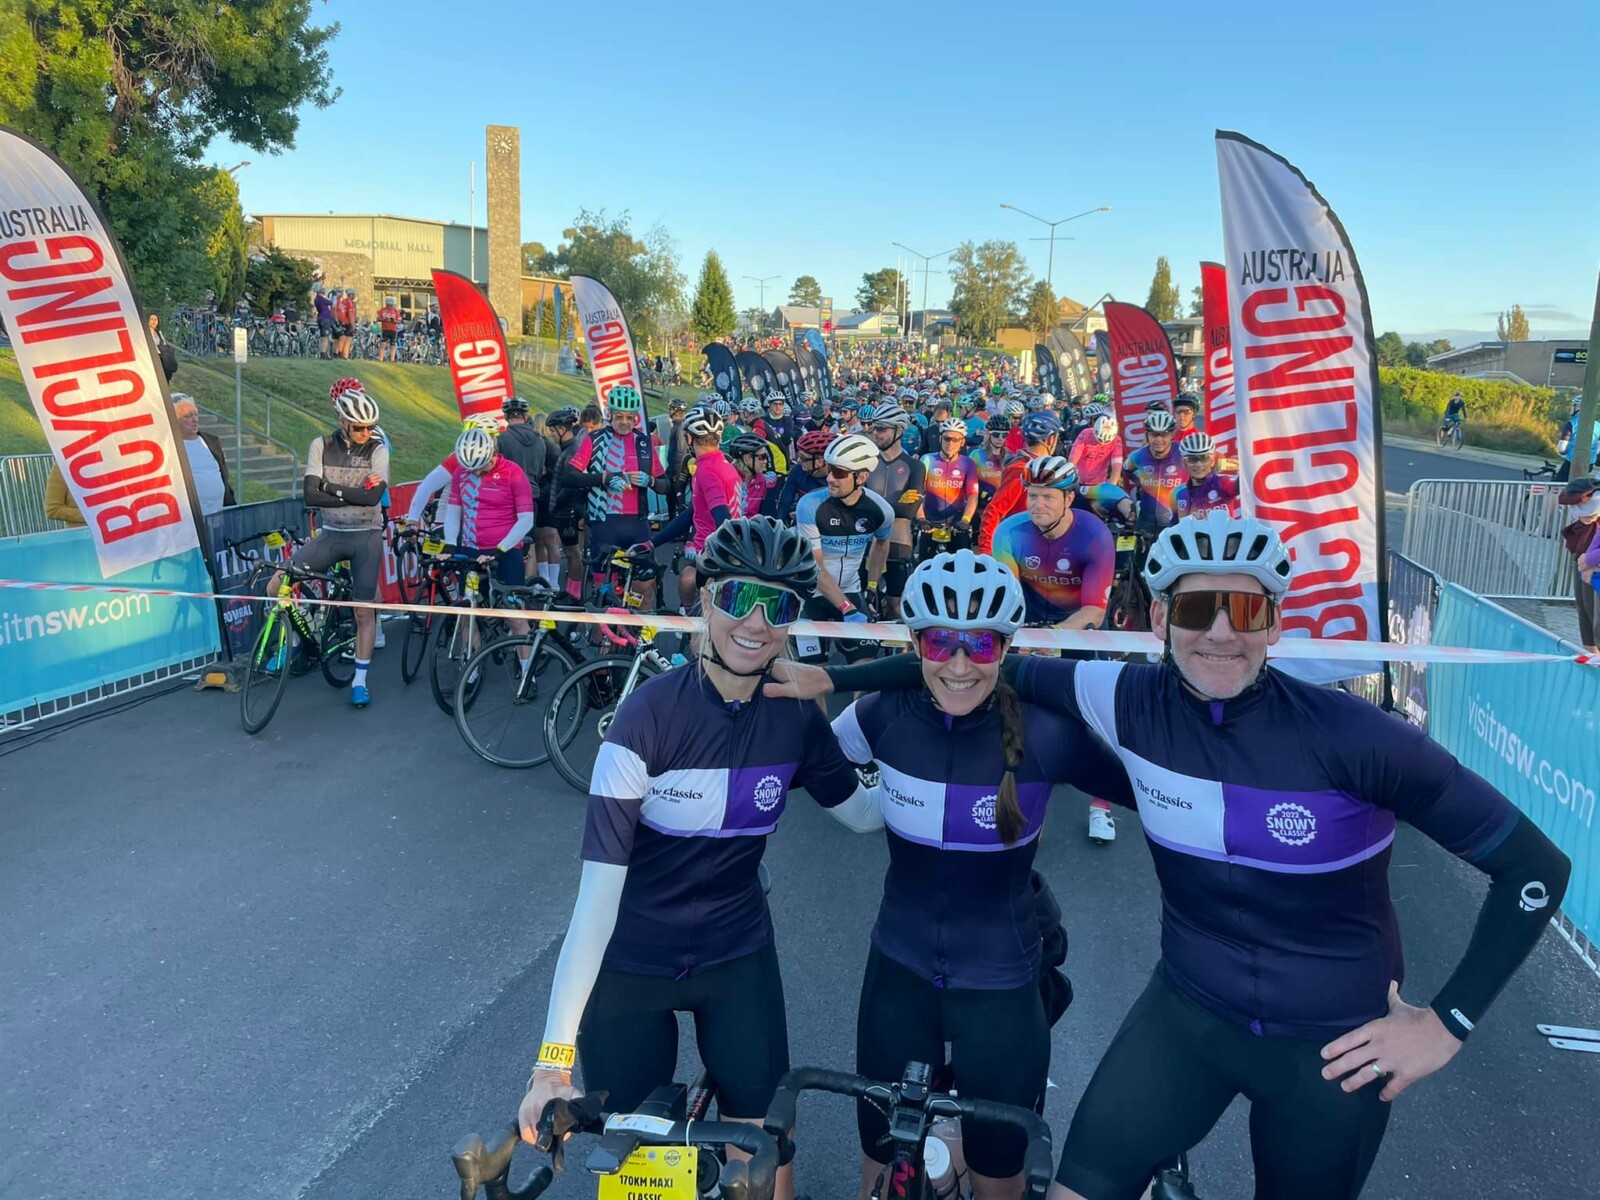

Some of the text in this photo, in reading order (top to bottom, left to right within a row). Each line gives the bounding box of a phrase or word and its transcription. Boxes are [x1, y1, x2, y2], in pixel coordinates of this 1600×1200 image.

[0, 205, 93, 239] USTRALIA
[345, 239, 434, 253] MEMORIAL HALL
[1241, 249, 1345, 285] AUSTRALIA
[585, 308, 620, 325] AUSTRALIA
[452, 321, 498, 341] AUSTRALIA
[1117, 341, 1164, 357] AUSTRALIA
[0, 235, 182, 545] BICYCLING
[821, 537, 871, 547] CANBERRA
[216, 549, 259, 579] The
[0, 593, 151, 645] itnsw.com
[1468, 693, 1596, 829] visitnsw.com
[663, 787, 703, 800] Classics
[754, 786, 782, 800] SNOWY
[891, 788, 925, 808] Classics
[1136, 777, 1193, 810] The Classics
[1266, 816, 1316, 830] SNOWY
[1280, 829, 1308, 837] CLASSIC
[545, 1045, 574, 1062] 1057
[619, 1174, 673, 1188] 170KM MAXI
